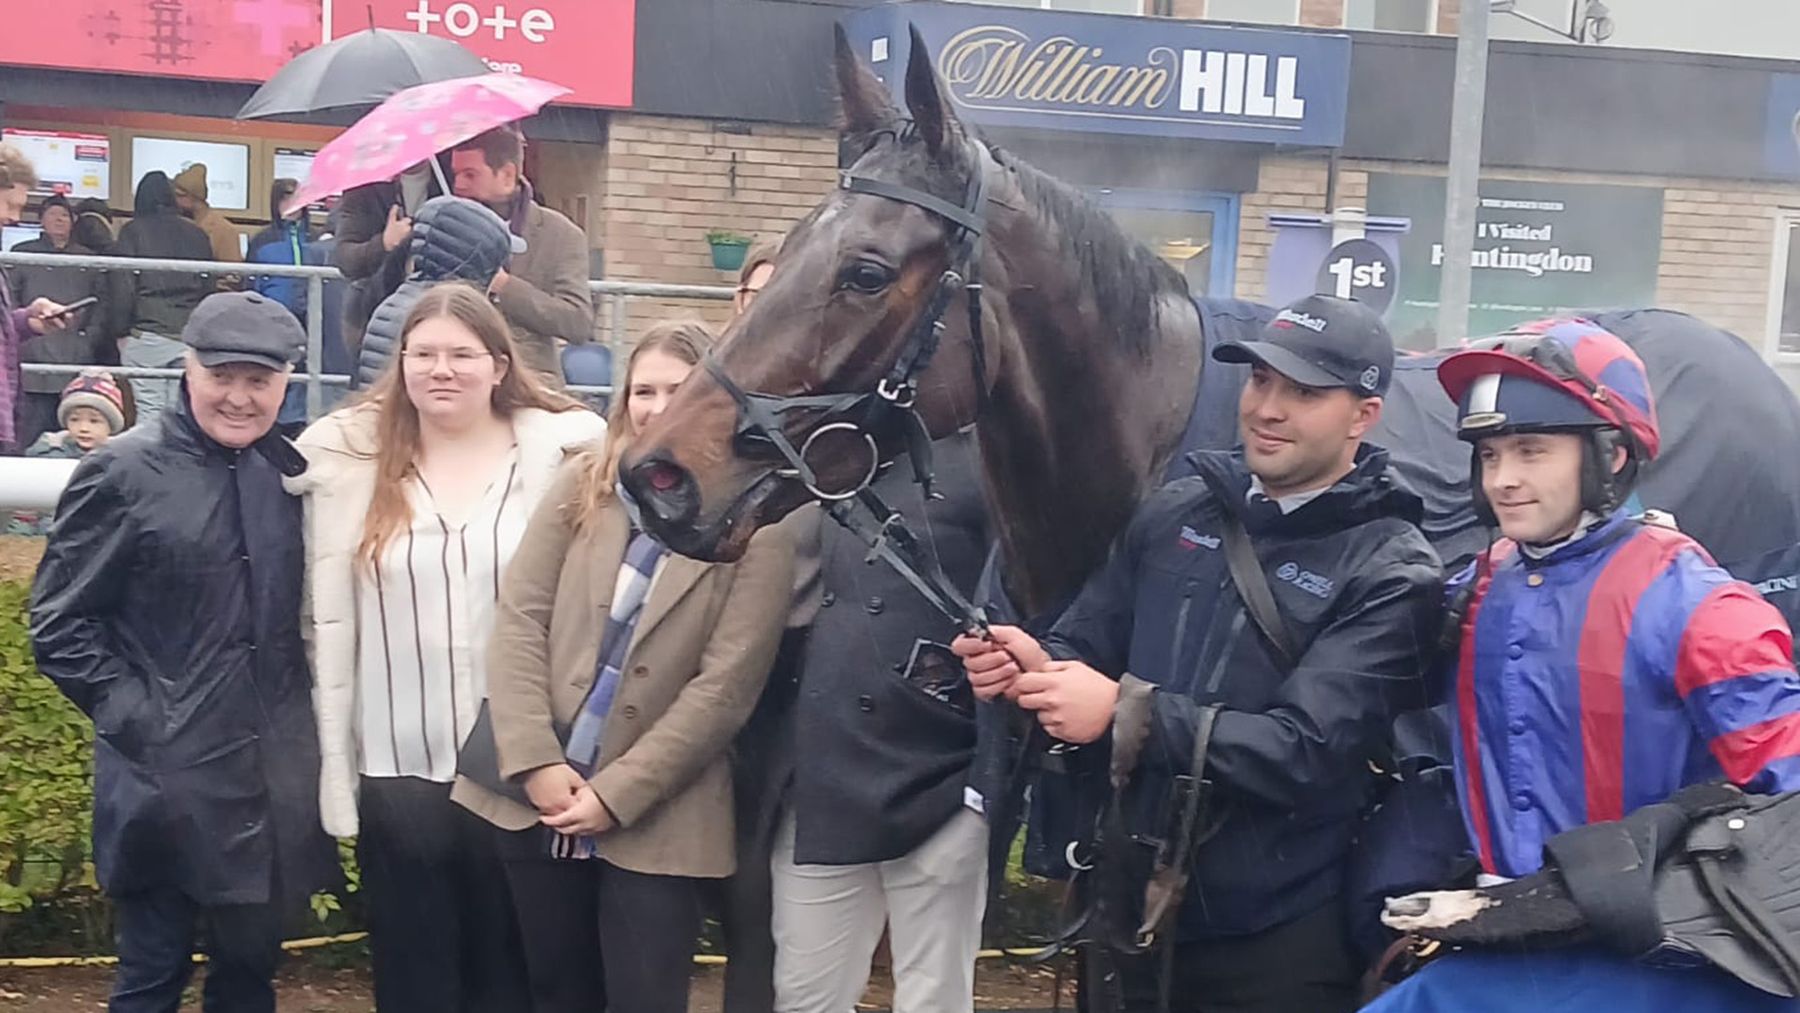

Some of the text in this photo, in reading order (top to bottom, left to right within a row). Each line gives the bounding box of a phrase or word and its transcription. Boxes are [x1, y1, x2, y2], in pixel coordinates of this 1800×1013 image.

[406, 0, 555, 43] tote
[481, 57, 523, 73] ere
[938, 25, 1304, 119] William HILL
[1478, 223, 1552, 241] I Visited
[1329, 257, 1386, 299] 1st
[1431, 244, 1592, 277] Hntingdon
